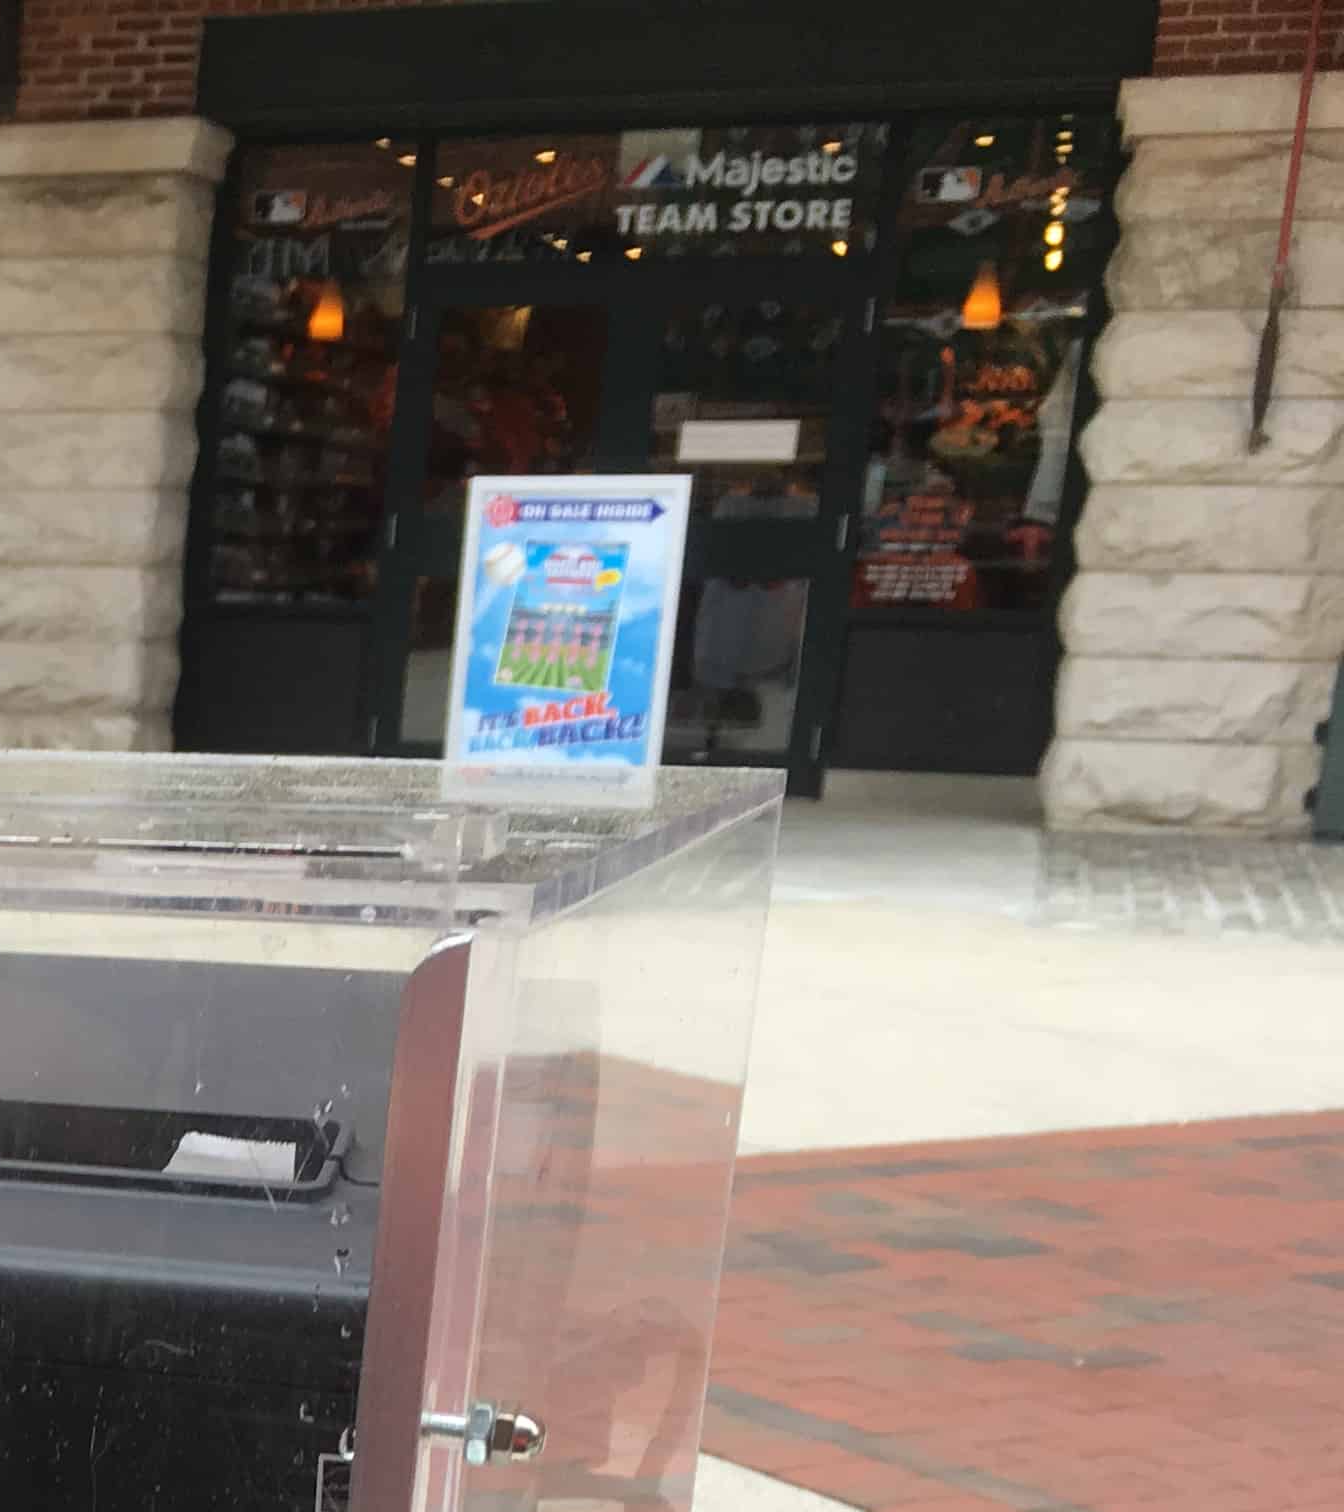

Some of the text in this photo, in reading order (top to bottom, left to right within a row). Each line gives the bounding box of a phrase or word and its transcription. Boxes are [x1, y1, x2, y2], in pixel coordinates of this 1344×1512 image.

[685, 149, 859, 197] Majestic
[616, 199, 853, 235] TEAM STORE
